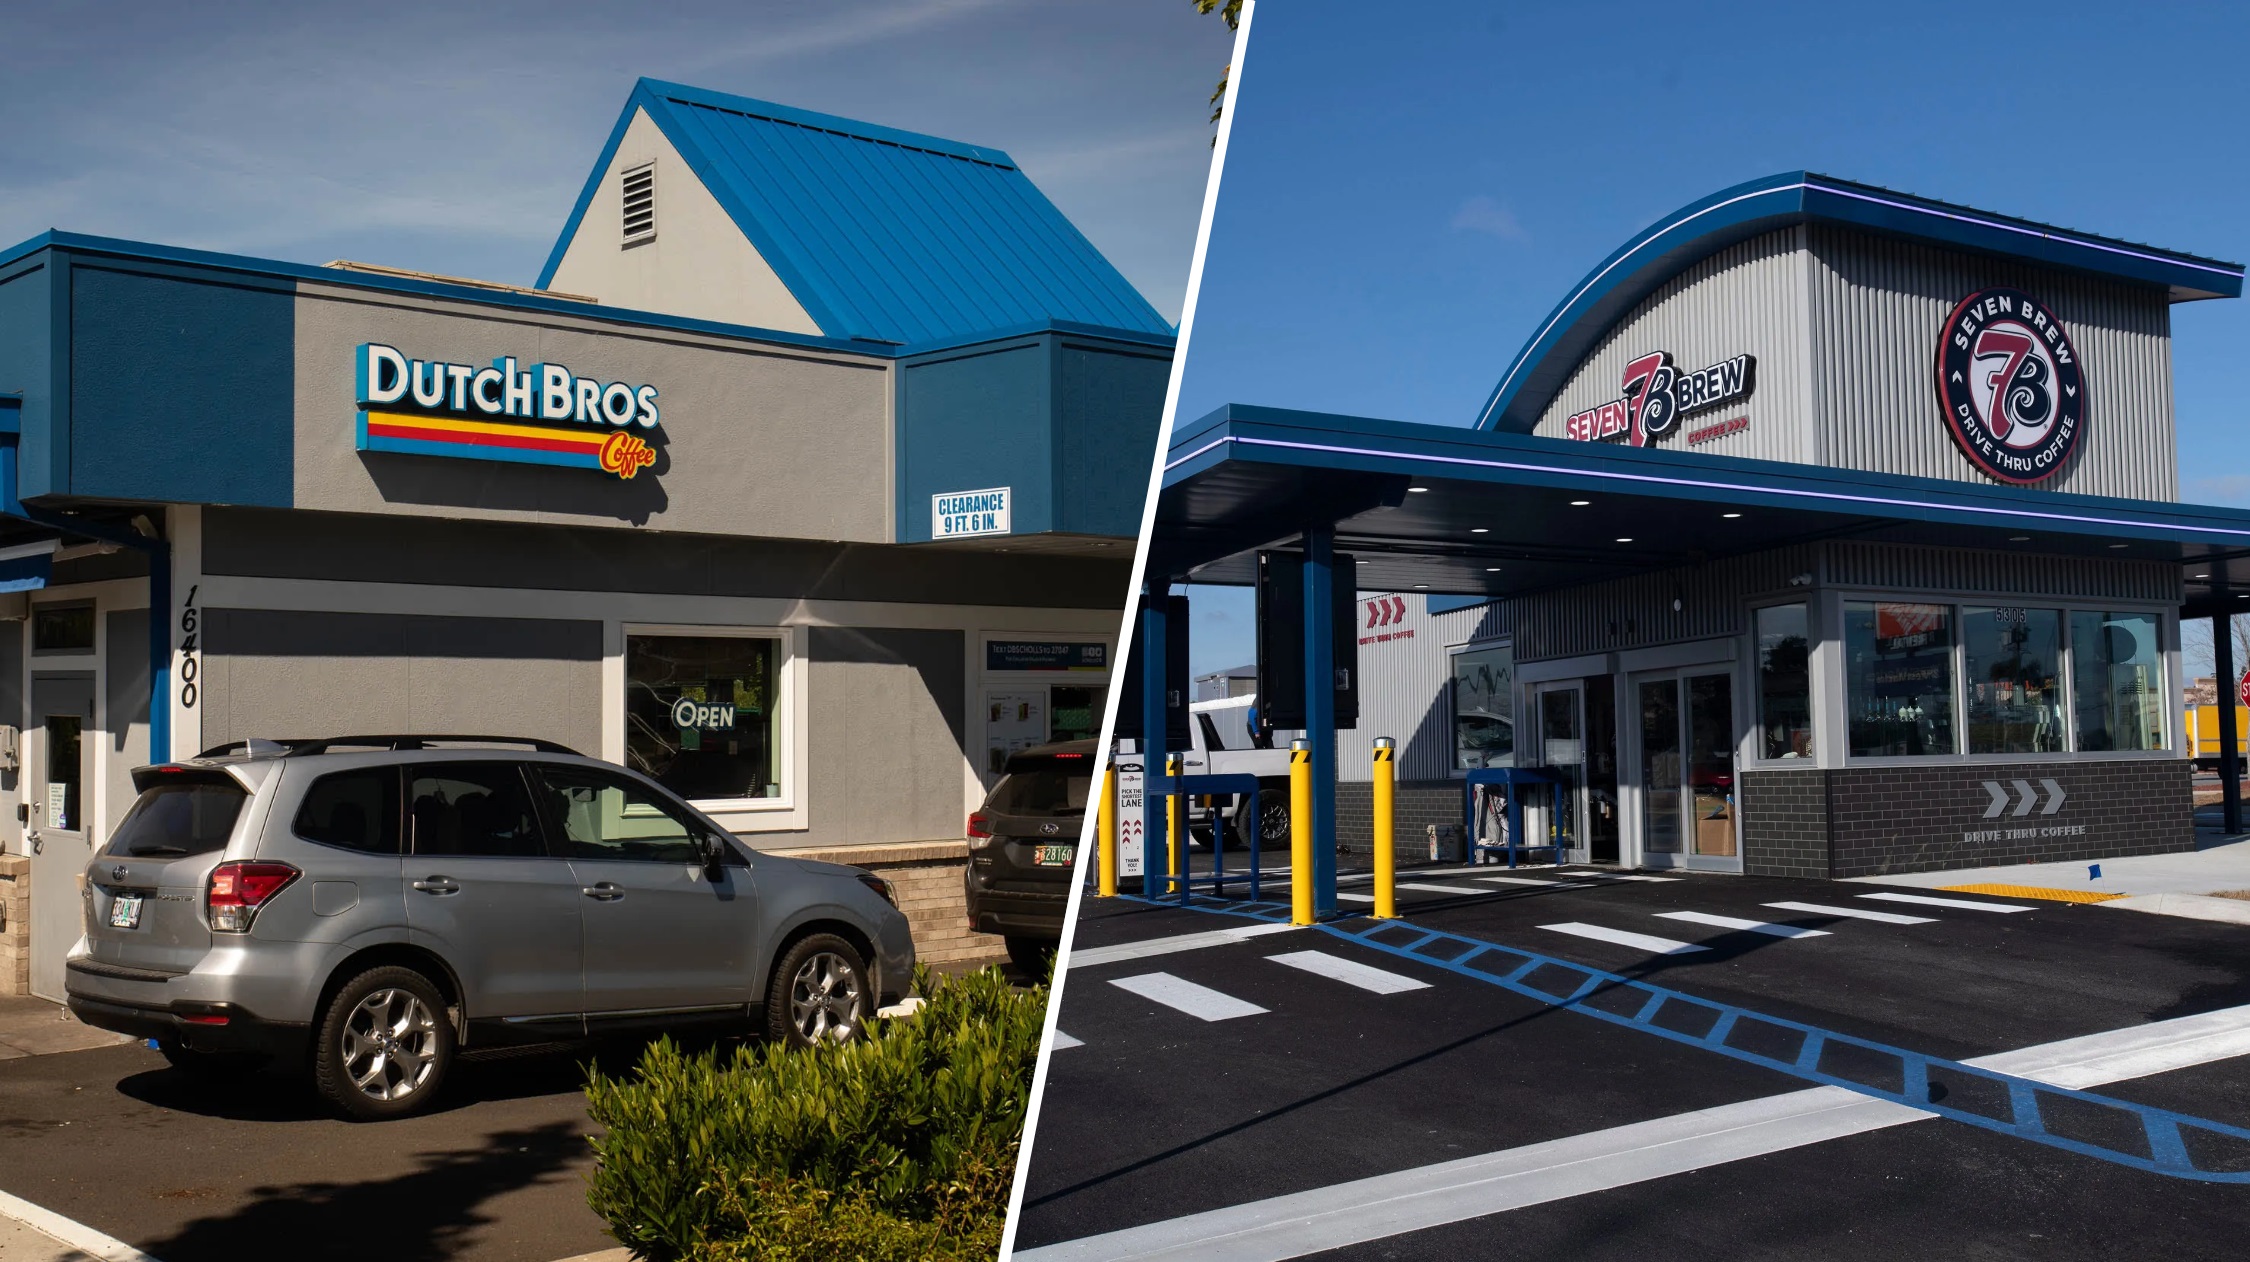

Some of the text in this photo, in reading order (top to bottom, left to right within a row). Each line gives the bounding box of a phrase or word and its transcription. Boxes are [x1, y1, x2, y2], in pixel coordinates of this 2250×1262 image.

[1955, 295, 2073, 365] SEVEN BREW
[1566, 397, 1629, 442] SEVEN
[1677, 354, 1747, 412] BREW
[1688, 421, 1726, 445] COFFEE
[1957, 402, 2075, 472] DRIVE THRU COFFEE
[601, 432, 655, 478] Coffee
[938, 493, 1004, 516] CLEARANCE
[944, 512, 998, 534] 9 FT. 6 IN.
[1995, 607, 2027, 624] 5305
[180, 584, 198, 709] 16400
[676, 701, 734, 727] OPEN
[1121, 799, 1143, 808] LANE
[1964, 825, 2087, 843] DRIVE THRU COFFEE
